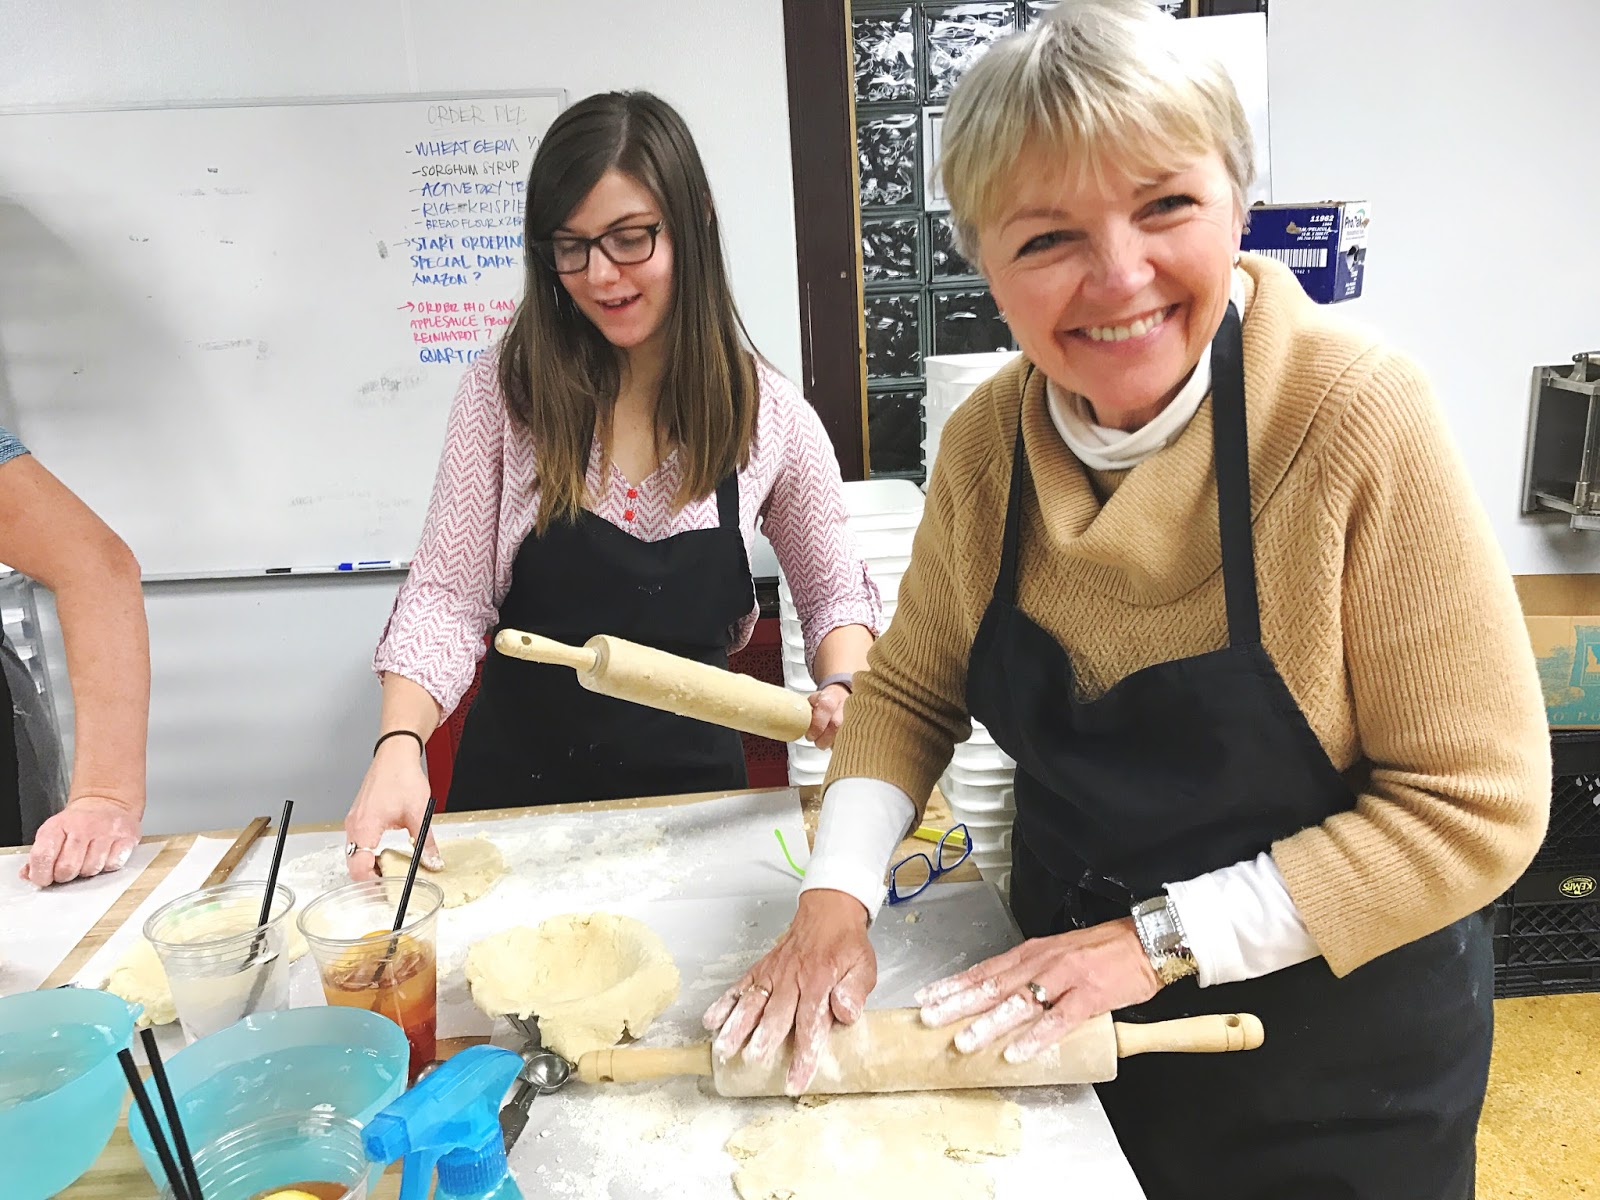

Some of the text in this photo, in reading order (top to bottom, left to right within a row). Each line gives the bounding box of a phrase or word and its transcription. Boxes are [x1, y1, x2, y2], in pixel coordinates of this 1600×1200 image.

[427, 104, 485, 126] ORDER
[415, 139, 471, 156] WHEAT
[474, 138, 519, 155] GERM
[421, 160, 519, 176] SORGHUM SYRUP
[421, 182, 472, 198] ACTIVE
[426, 219, 460, 229] BREAD
[462, 218, 498, 229] FLOUR
[411, 234, 454, 251] START
[410, 254, 518, 270] SPECIAL DARK
[412, 273, 468, 287] AMAZON
[417, 301, 459, 314] ORDER
[410, 315, 514, 329] APPLESAUCE FROM
[420, 347, 466, 364] QUART
[1562, 881, 1592, 894] KEMPS
